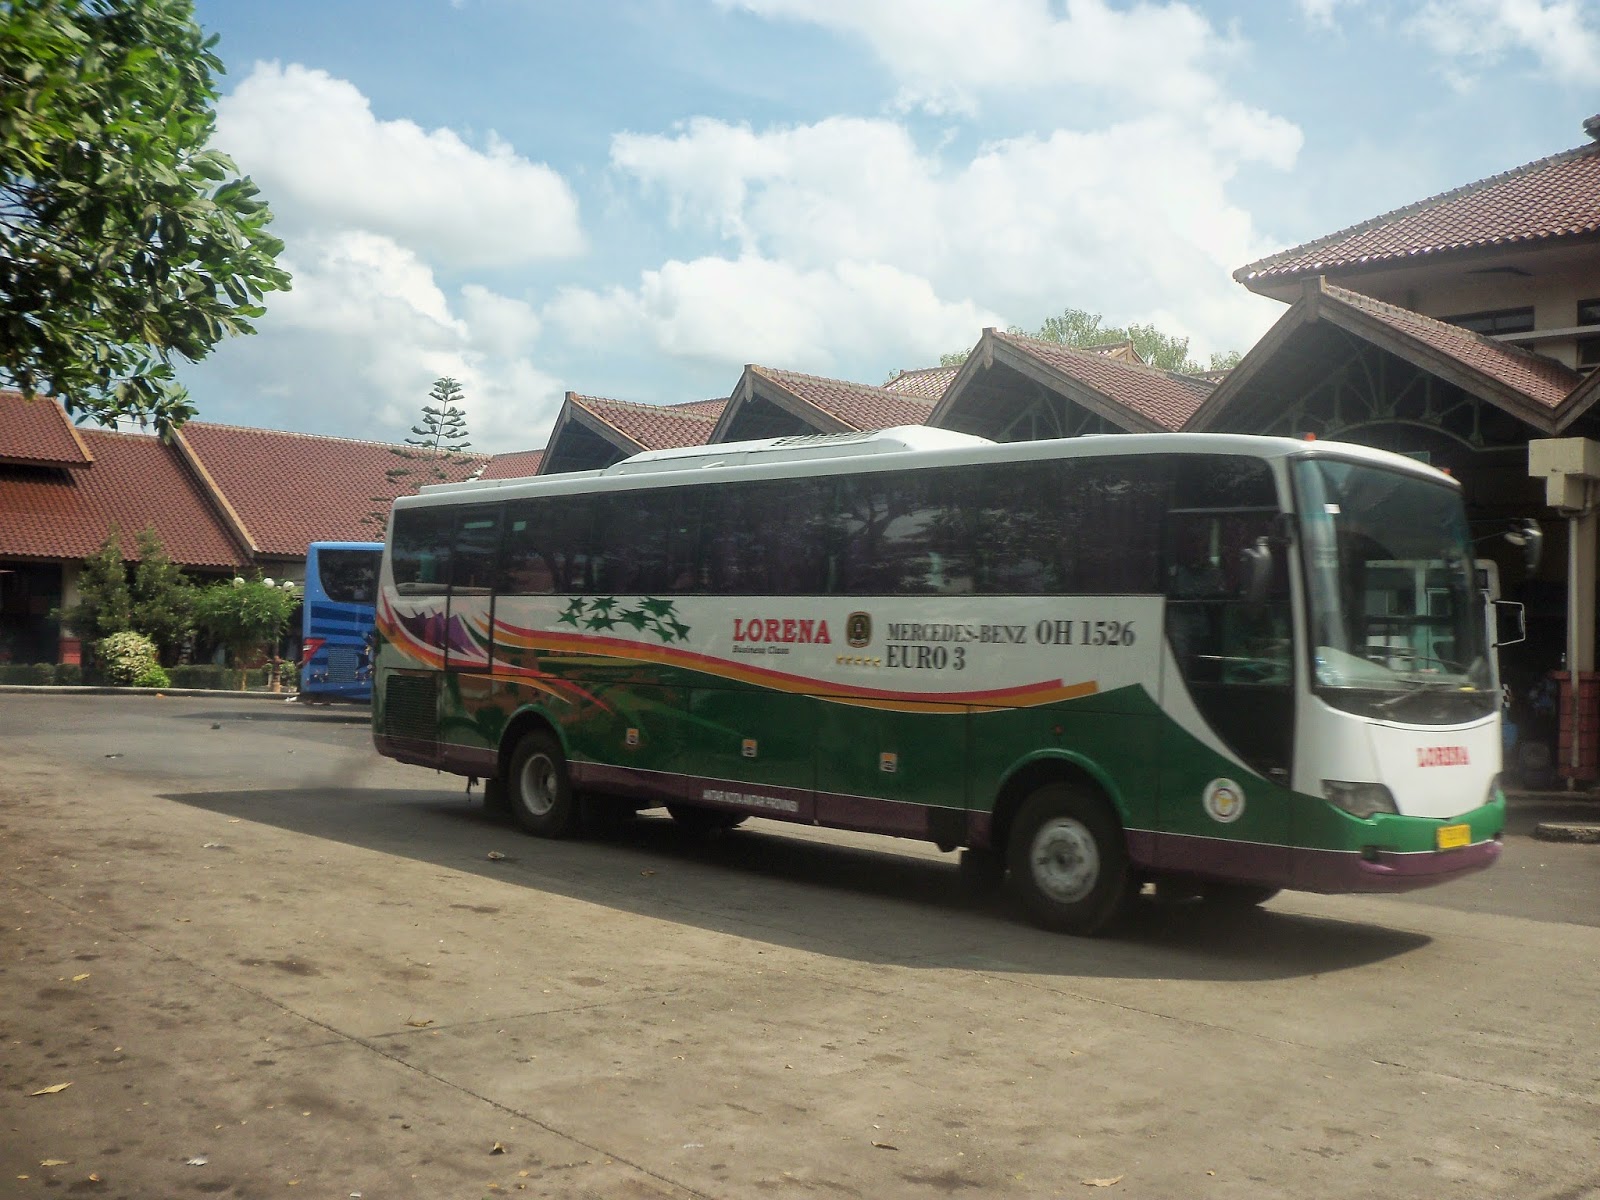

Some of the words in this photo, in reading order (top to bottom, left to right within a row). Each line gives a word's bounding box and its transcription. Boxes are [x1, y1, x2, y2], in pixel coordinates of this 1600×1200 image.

[733, 618, 832, 644] LORENA
[887, 623, 1027, 644] MERCEDES-BENZ
[1036, 620, 1073, 645] OH
[1080, 621, 1135, 647] 1526
[886, 645, 948, 669] EURO
[953, 647, 966, 670] 3
[1417, 747, 1469, 767] LORENA
